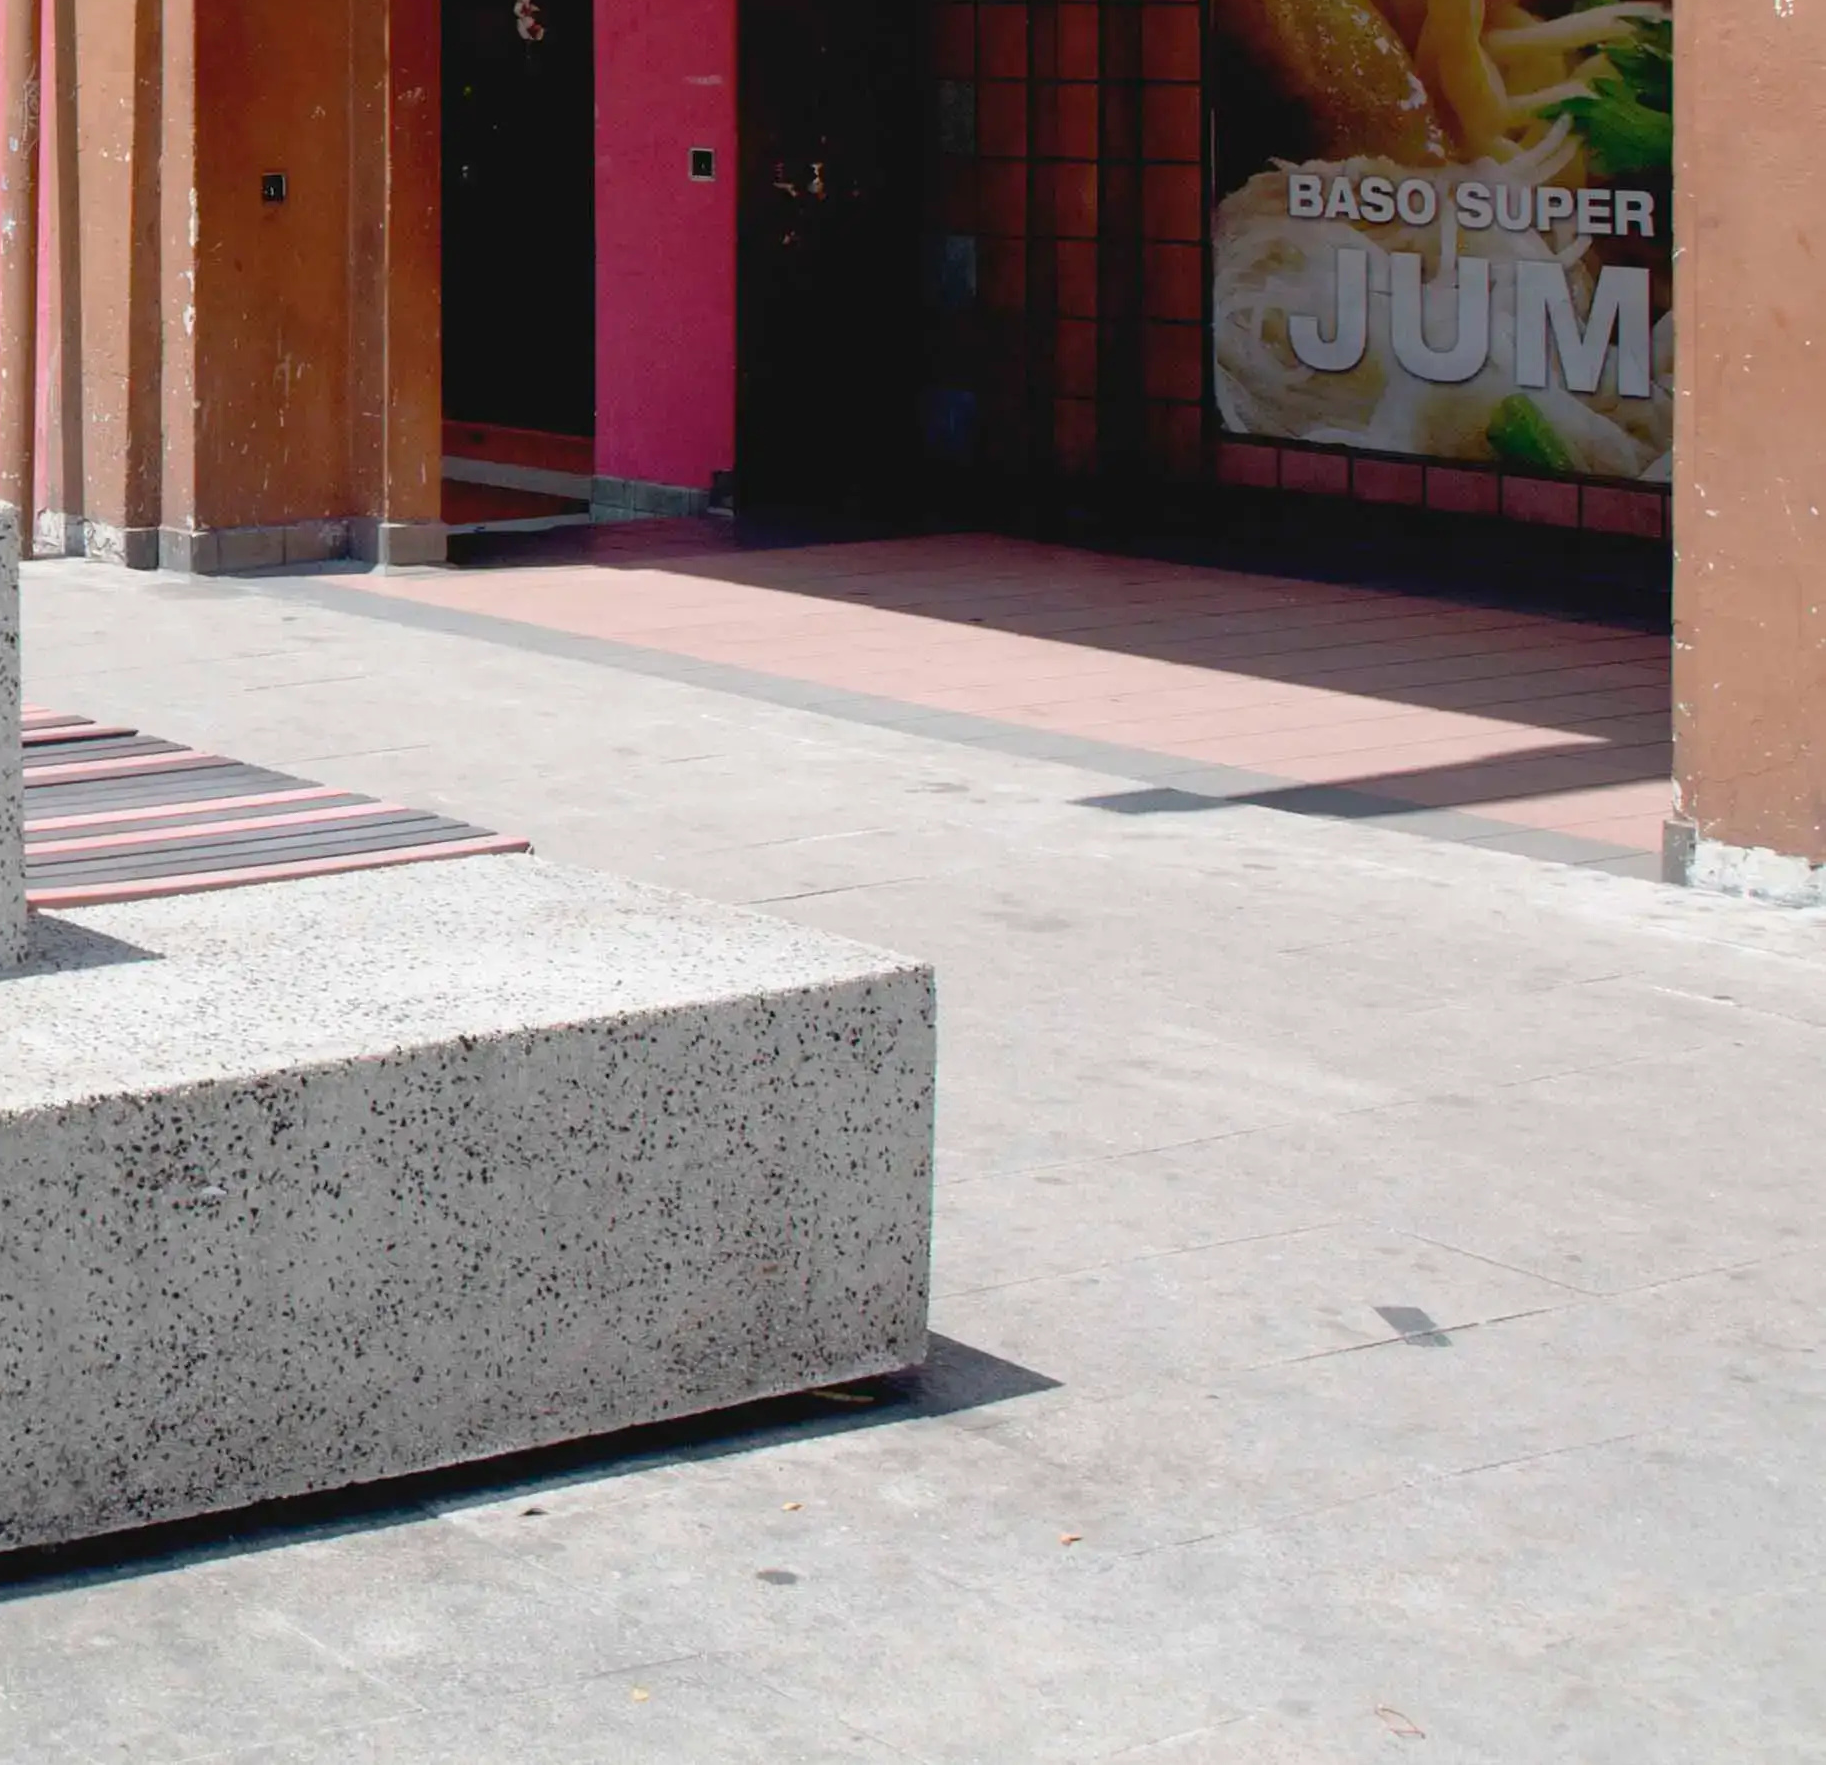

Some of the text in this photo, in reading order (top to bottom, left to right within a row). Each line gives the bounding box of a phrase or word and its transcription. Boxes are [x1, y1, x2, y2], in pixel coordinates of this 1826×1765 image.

[1288, 174, 1655, 238] BASO SUPER
[1288, 248, 1651, 399] JUM
